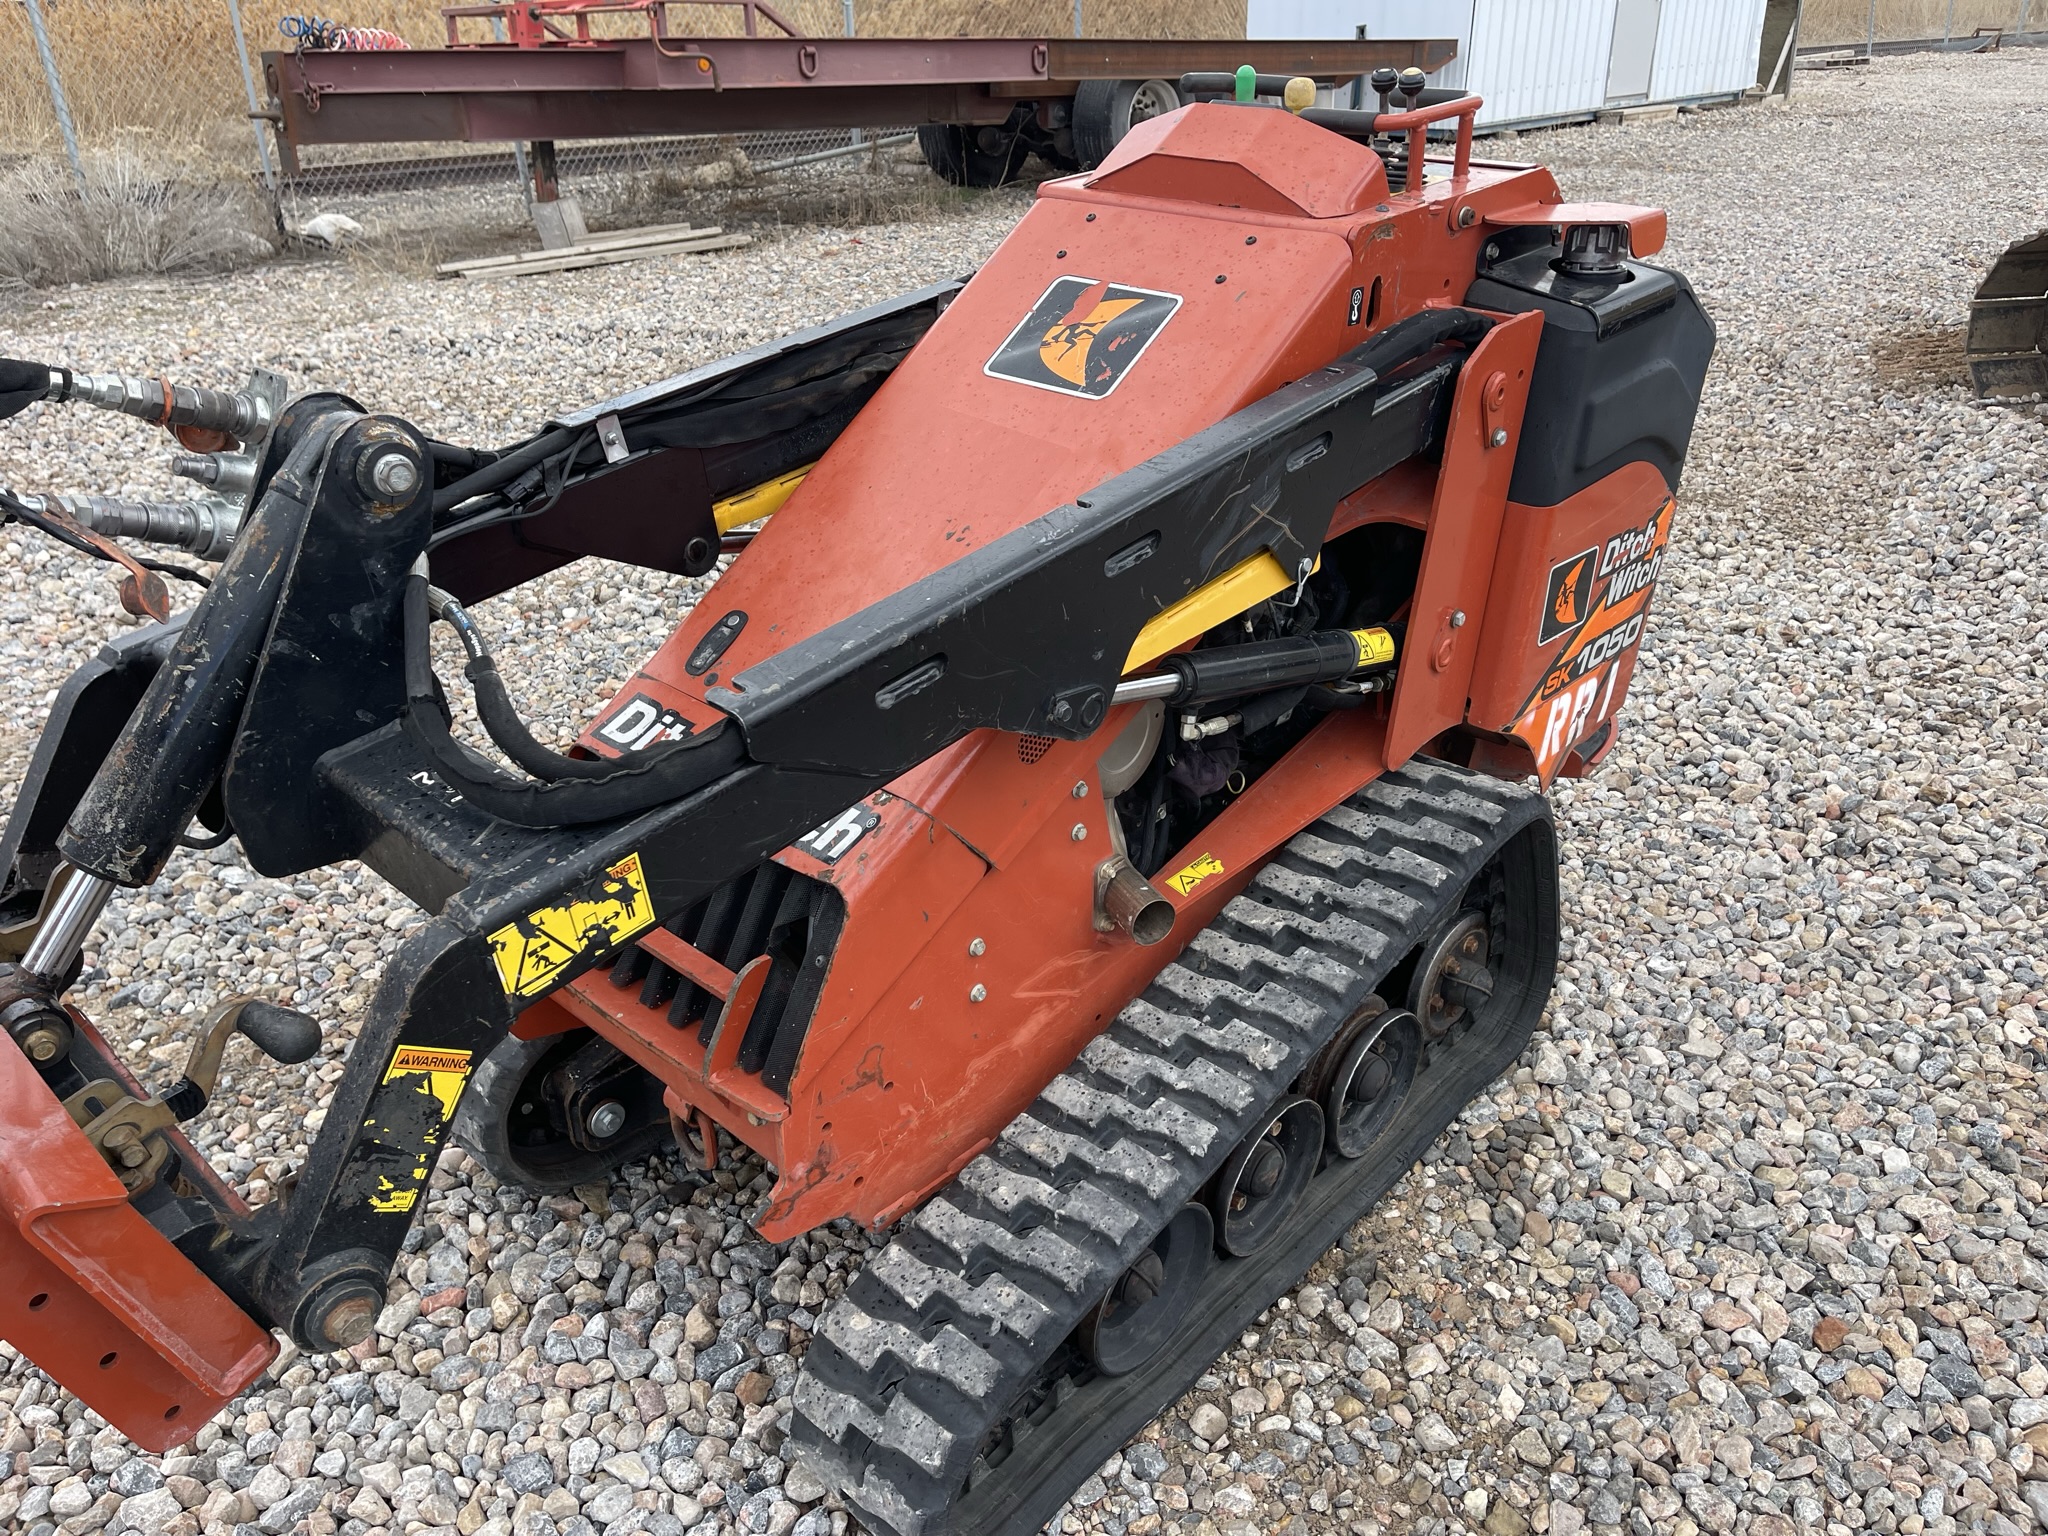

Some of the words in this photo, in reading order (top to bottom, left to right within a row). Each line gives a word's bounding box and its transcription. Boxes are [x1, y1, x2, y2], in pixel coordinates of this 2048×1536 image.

[1599, 520, 1656, 577] Ditch
[1606, 550, 1662, 607] Witch
[1544, 661, 1575, 695] SK
[1577, 614, 1643, 675] 1050
[411, 1054, 468, 1069] WARNING
